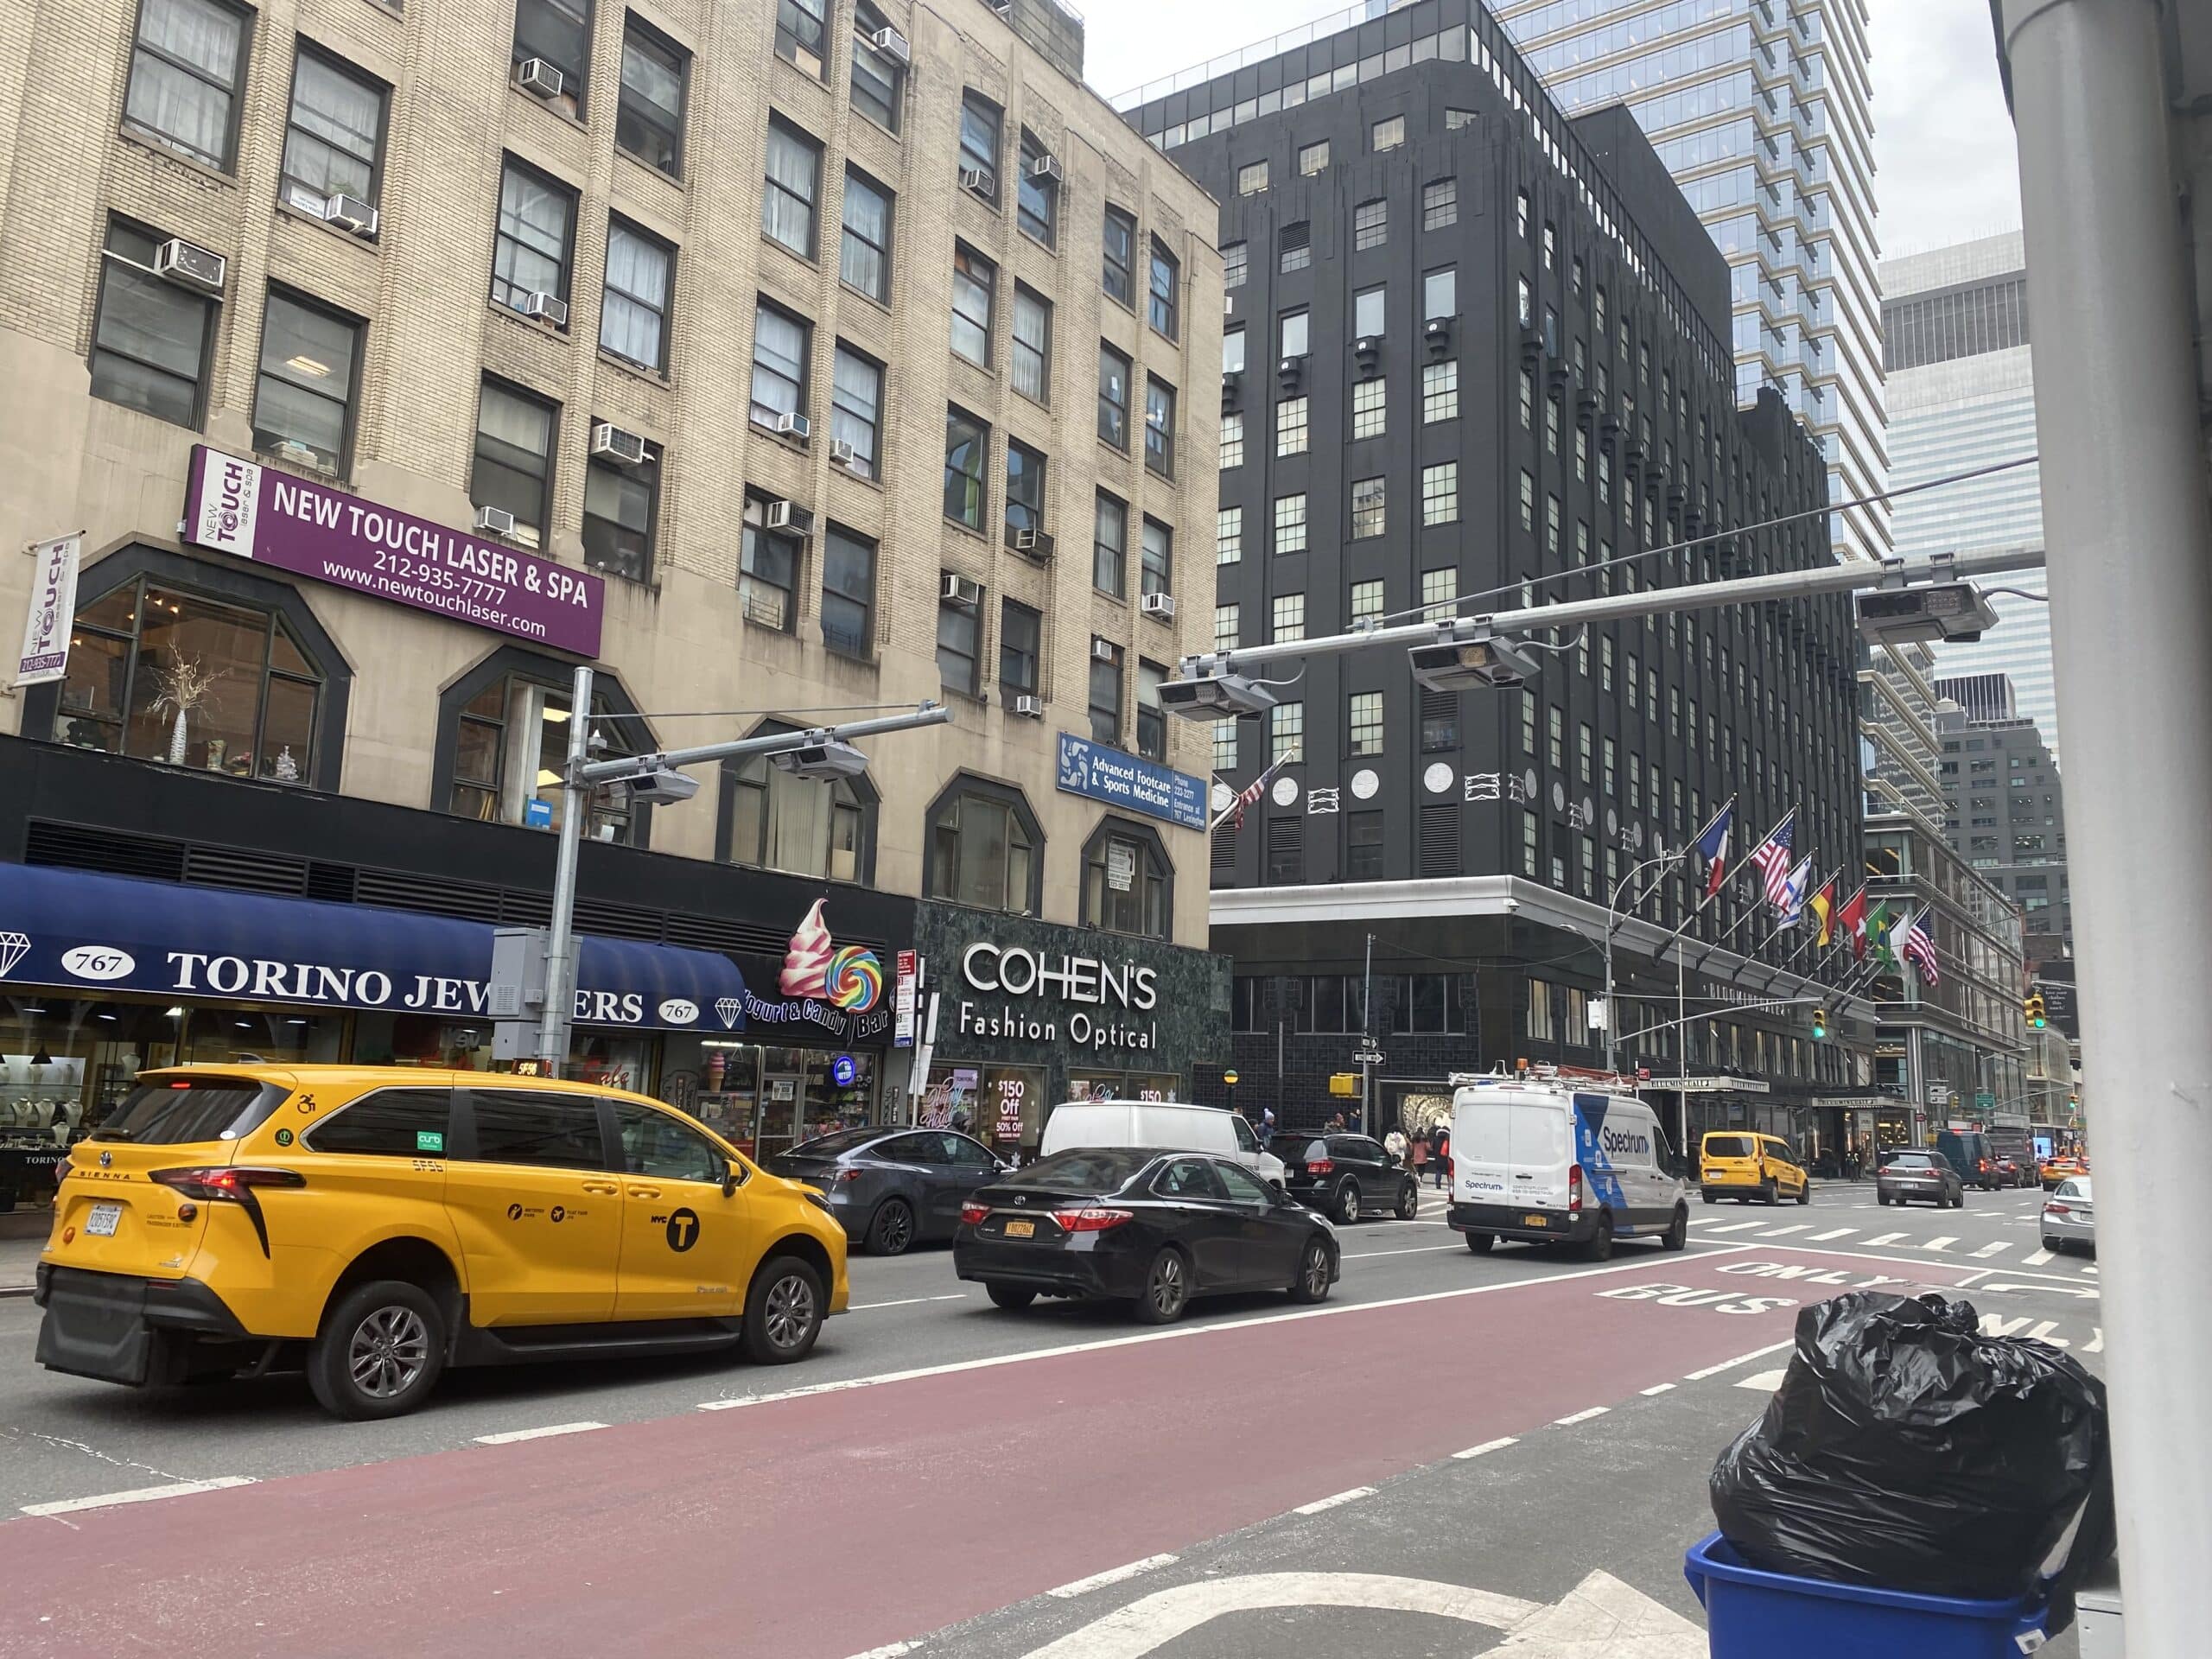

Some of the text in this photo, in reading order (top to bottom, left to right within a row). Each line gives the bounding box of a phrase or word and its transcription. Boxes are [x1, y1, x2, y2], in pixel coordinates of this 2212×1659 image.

[245, 468, 254, 486] spa
[218, 462, 244, 542] TOUCH
[241, 501, 250, 527] laser
[206, 504, 218, 540] NEW
[274, 481, 588, 608] NEW TOUCH LASER & SPA
[373, 550, 506, 605] 212-935-7777
[37, 543, 64, 654] TOUCH
[322, 560, 546, 637] www.newtouchlaser.com
[30, 610, 42, 655] NEW
[1091, 772, 1169, 808] & Sports Medicine
[1092, 756, 1172, 794] Advanced Footcare
[75, 952, 692, 1023] 767 TORINO JEWERS 767
[963, 942, 1158, 1010] COHEN'S
[790, 1002, 800, 1021] &
[803, 999, 847, 1035] Candy
[856, 1010, 888, 1038] Bar
[960, 1001, 1156, 1050] Fashion Optical
[581, 1059, 630, 1087] Sale
[998, 1080, 1024, 1097] $150
[1001, 1099, 1020, 1115] Off
[1141, 1090, 1161, 1103] $150
[418, 1135, 441, 1144] curb
[996, 1122, 1023, 1132] 50% Off
[1604, 1126, 1646, 1159] Spectrum
[25, 1156, 64, 1165] TORINO
[79, 1171, 130, 1179] SIENNA
[1465, 1180, 1501, 1191] Spectrum
[675, 1217, 693, 1247] T
[1714, 1261, 1908, 1288] ONLY
[1592, 1282, 1800, 1315] BUS
